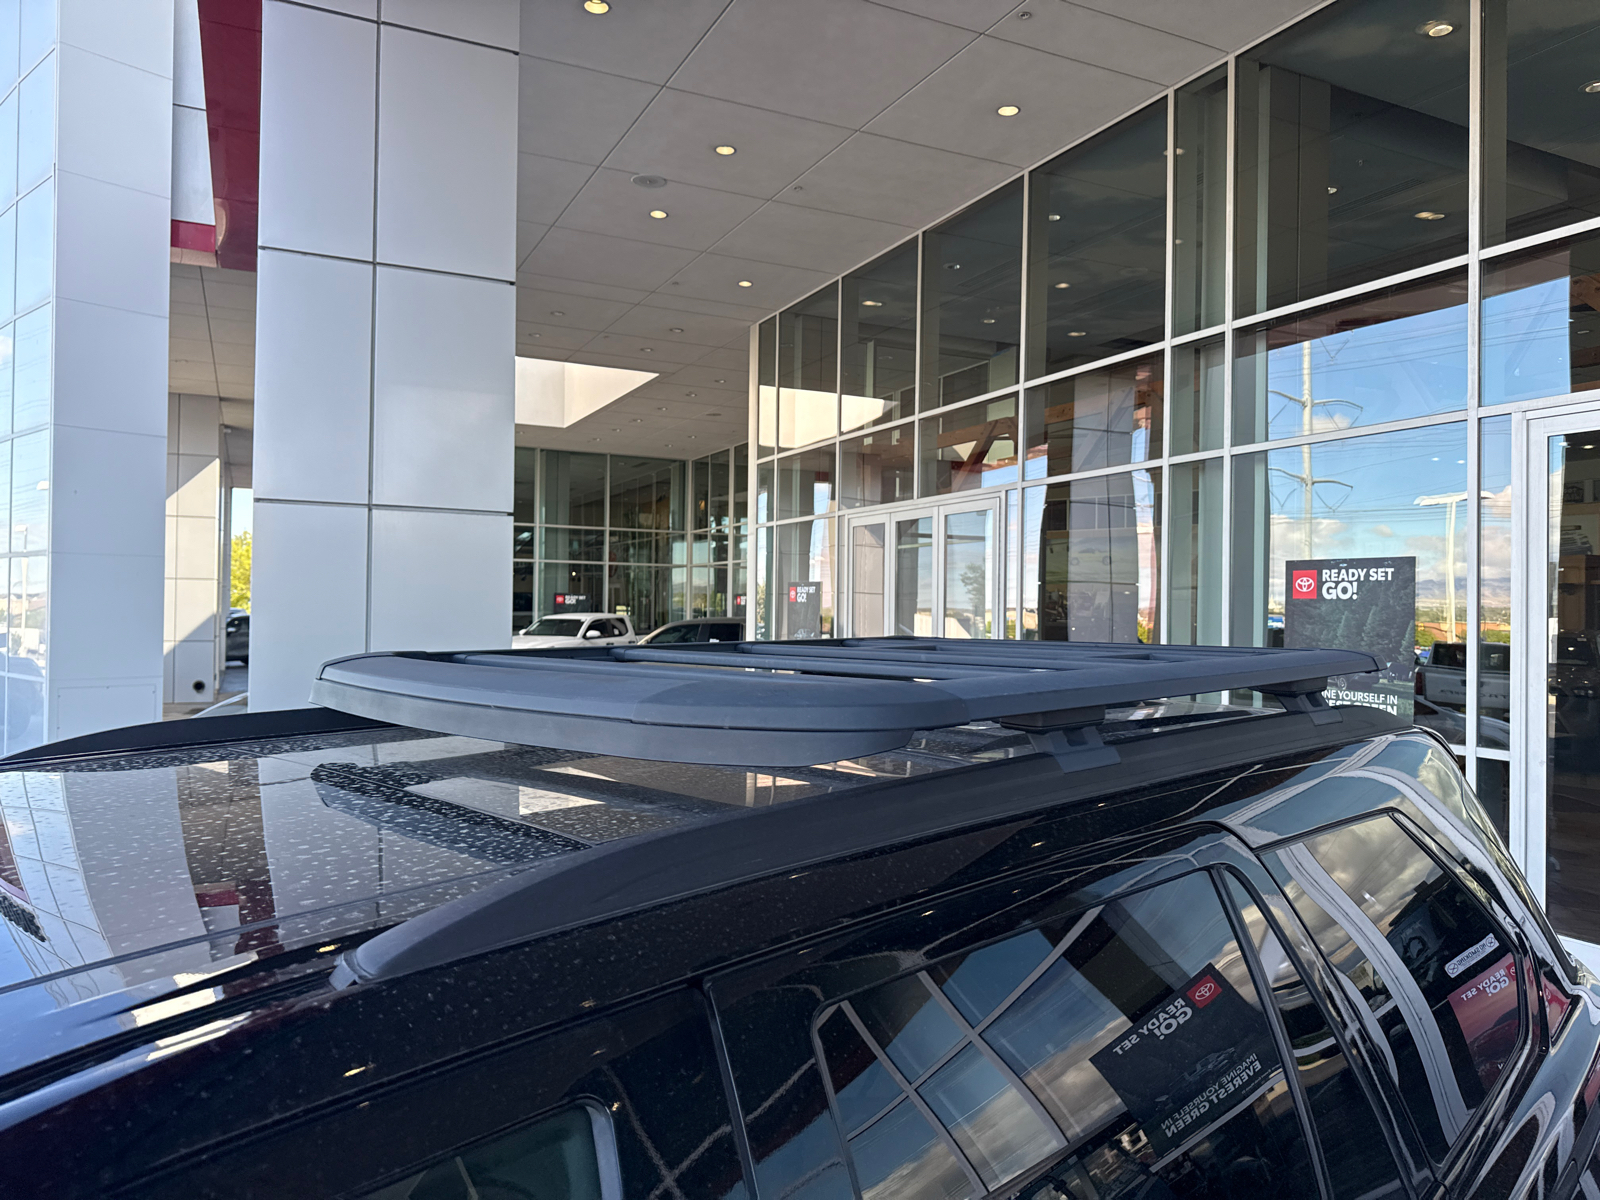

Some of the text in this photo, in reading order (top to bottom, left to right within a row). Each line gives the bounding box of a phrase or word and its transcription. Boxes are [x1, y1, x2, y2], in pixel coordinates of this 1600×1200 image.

[1322, 568, 1394, 581] READY SET
[1322, 581, 1358, 600] GO!
[1337, 690, 1385, 703] YOURSELF
[1387, 694, 1398, 705] IN
